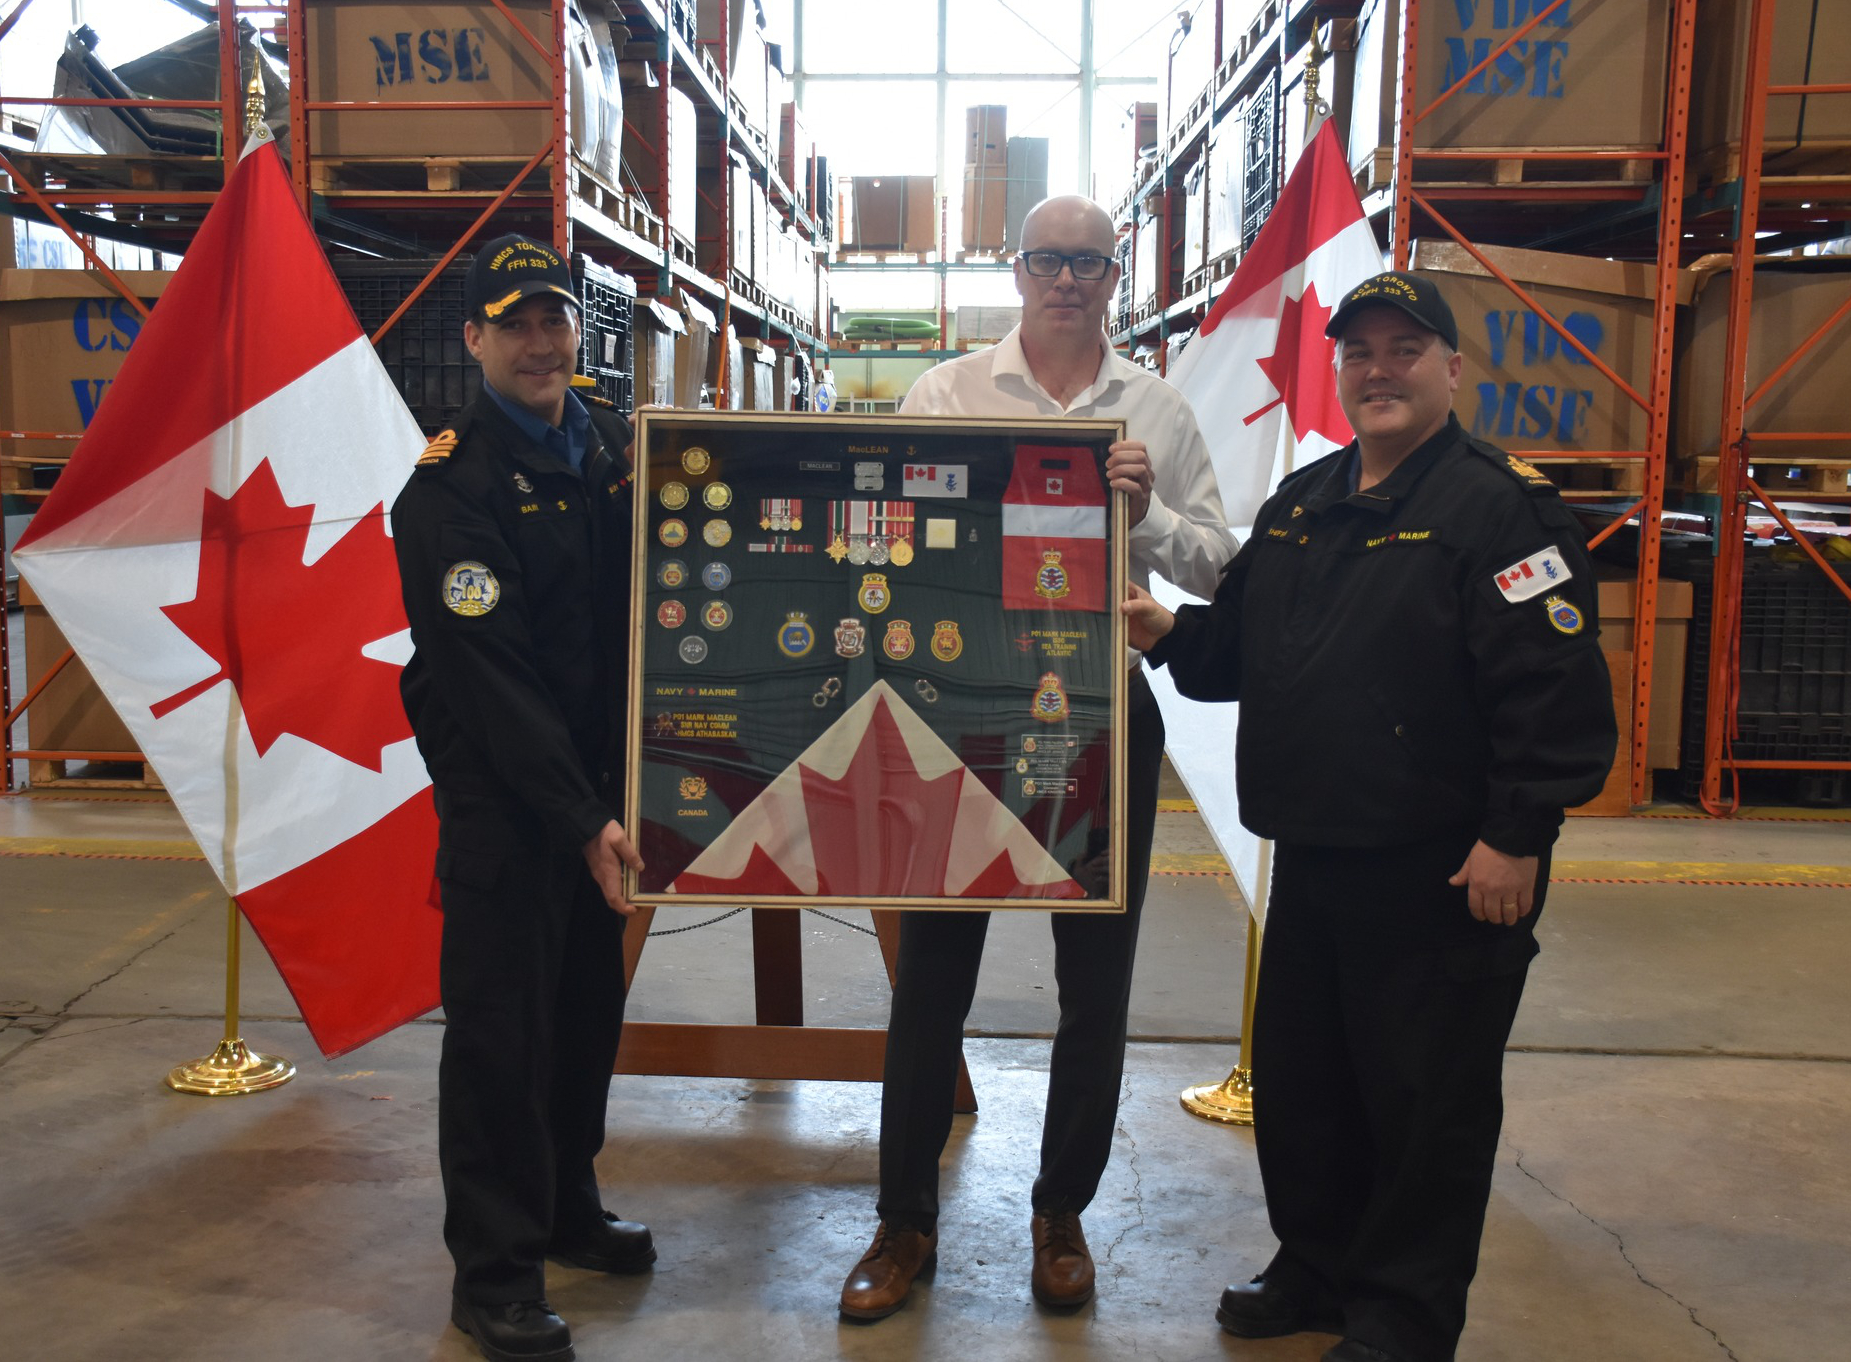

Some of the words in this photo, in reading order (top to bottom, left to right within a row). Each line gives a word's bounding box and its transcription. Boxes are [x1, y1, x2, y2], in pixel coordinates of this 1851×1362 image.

[369, 29, 490, 86] MSE
[1440, 37, 1569, 98] MSE
[490, 246, 514, 270] HMCS
[515, 242, 559, 266] TORNTO
[507, 258, 527, 271] FFH
[530, 258, 547, 269] 333
[1376, 276, 1418, 301] TORONTO
[1384, 286, 1401, 296] 333
[1485, 310, 1604, 368] VDO
[1471, 382, 1594, 443] MSE
[848, 445, 889, 454] MacLEAN
[1366, 536, 1387, 547] NAVY
[1398, 531, 1430, 540] MARINE
[461, 584, 482, 600] 100
[656, 687, 683, 695] NAVY
[699, 688, 737, 696] MARINE
[686, 713, 705, 721] MARK
[707, 713, 737, 721] MACLEAN
[694, 721, 708, 729] NAV
